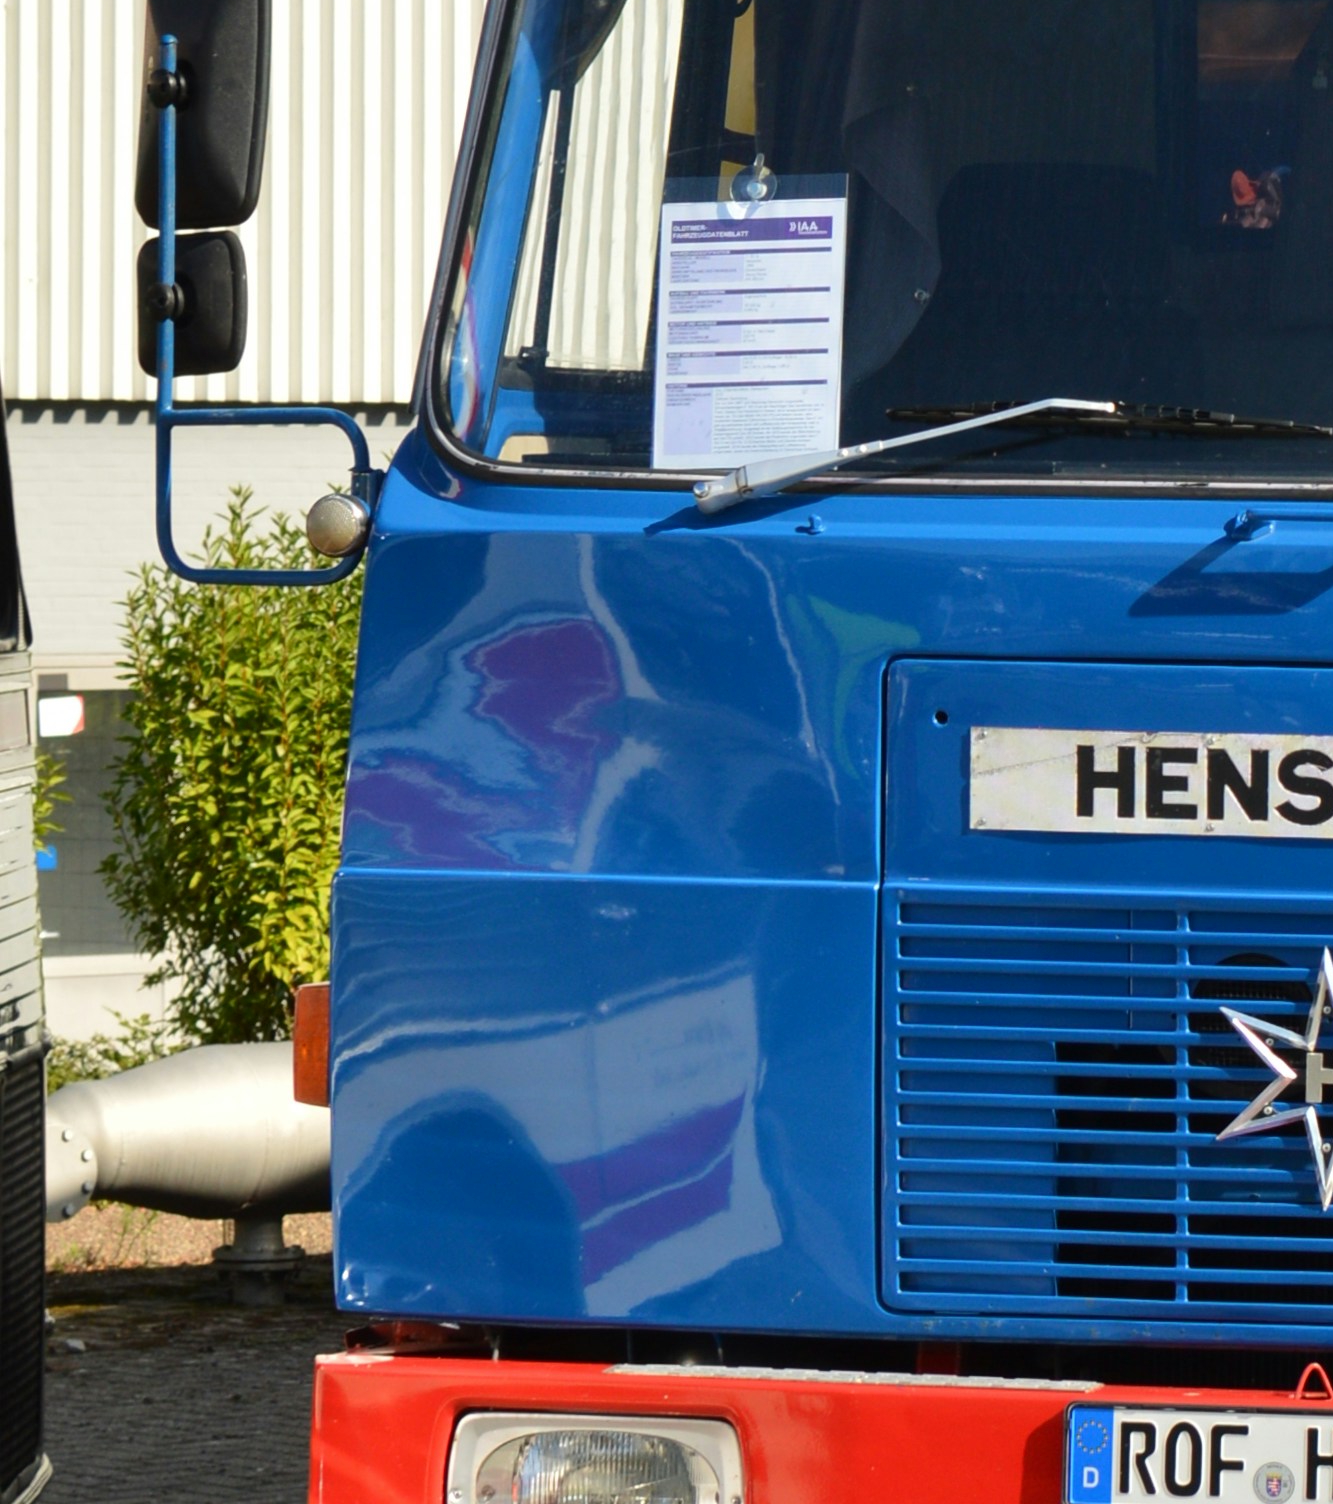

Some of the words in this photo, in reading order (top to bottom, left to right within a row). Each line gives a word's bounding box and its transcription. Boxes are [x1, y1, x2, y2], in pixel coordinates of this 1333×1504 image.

[797, 221, 819, 232] IAA
[1119, 1421, 1249, 1498] ROF
[1083, 1466, 1100, 1490] D
